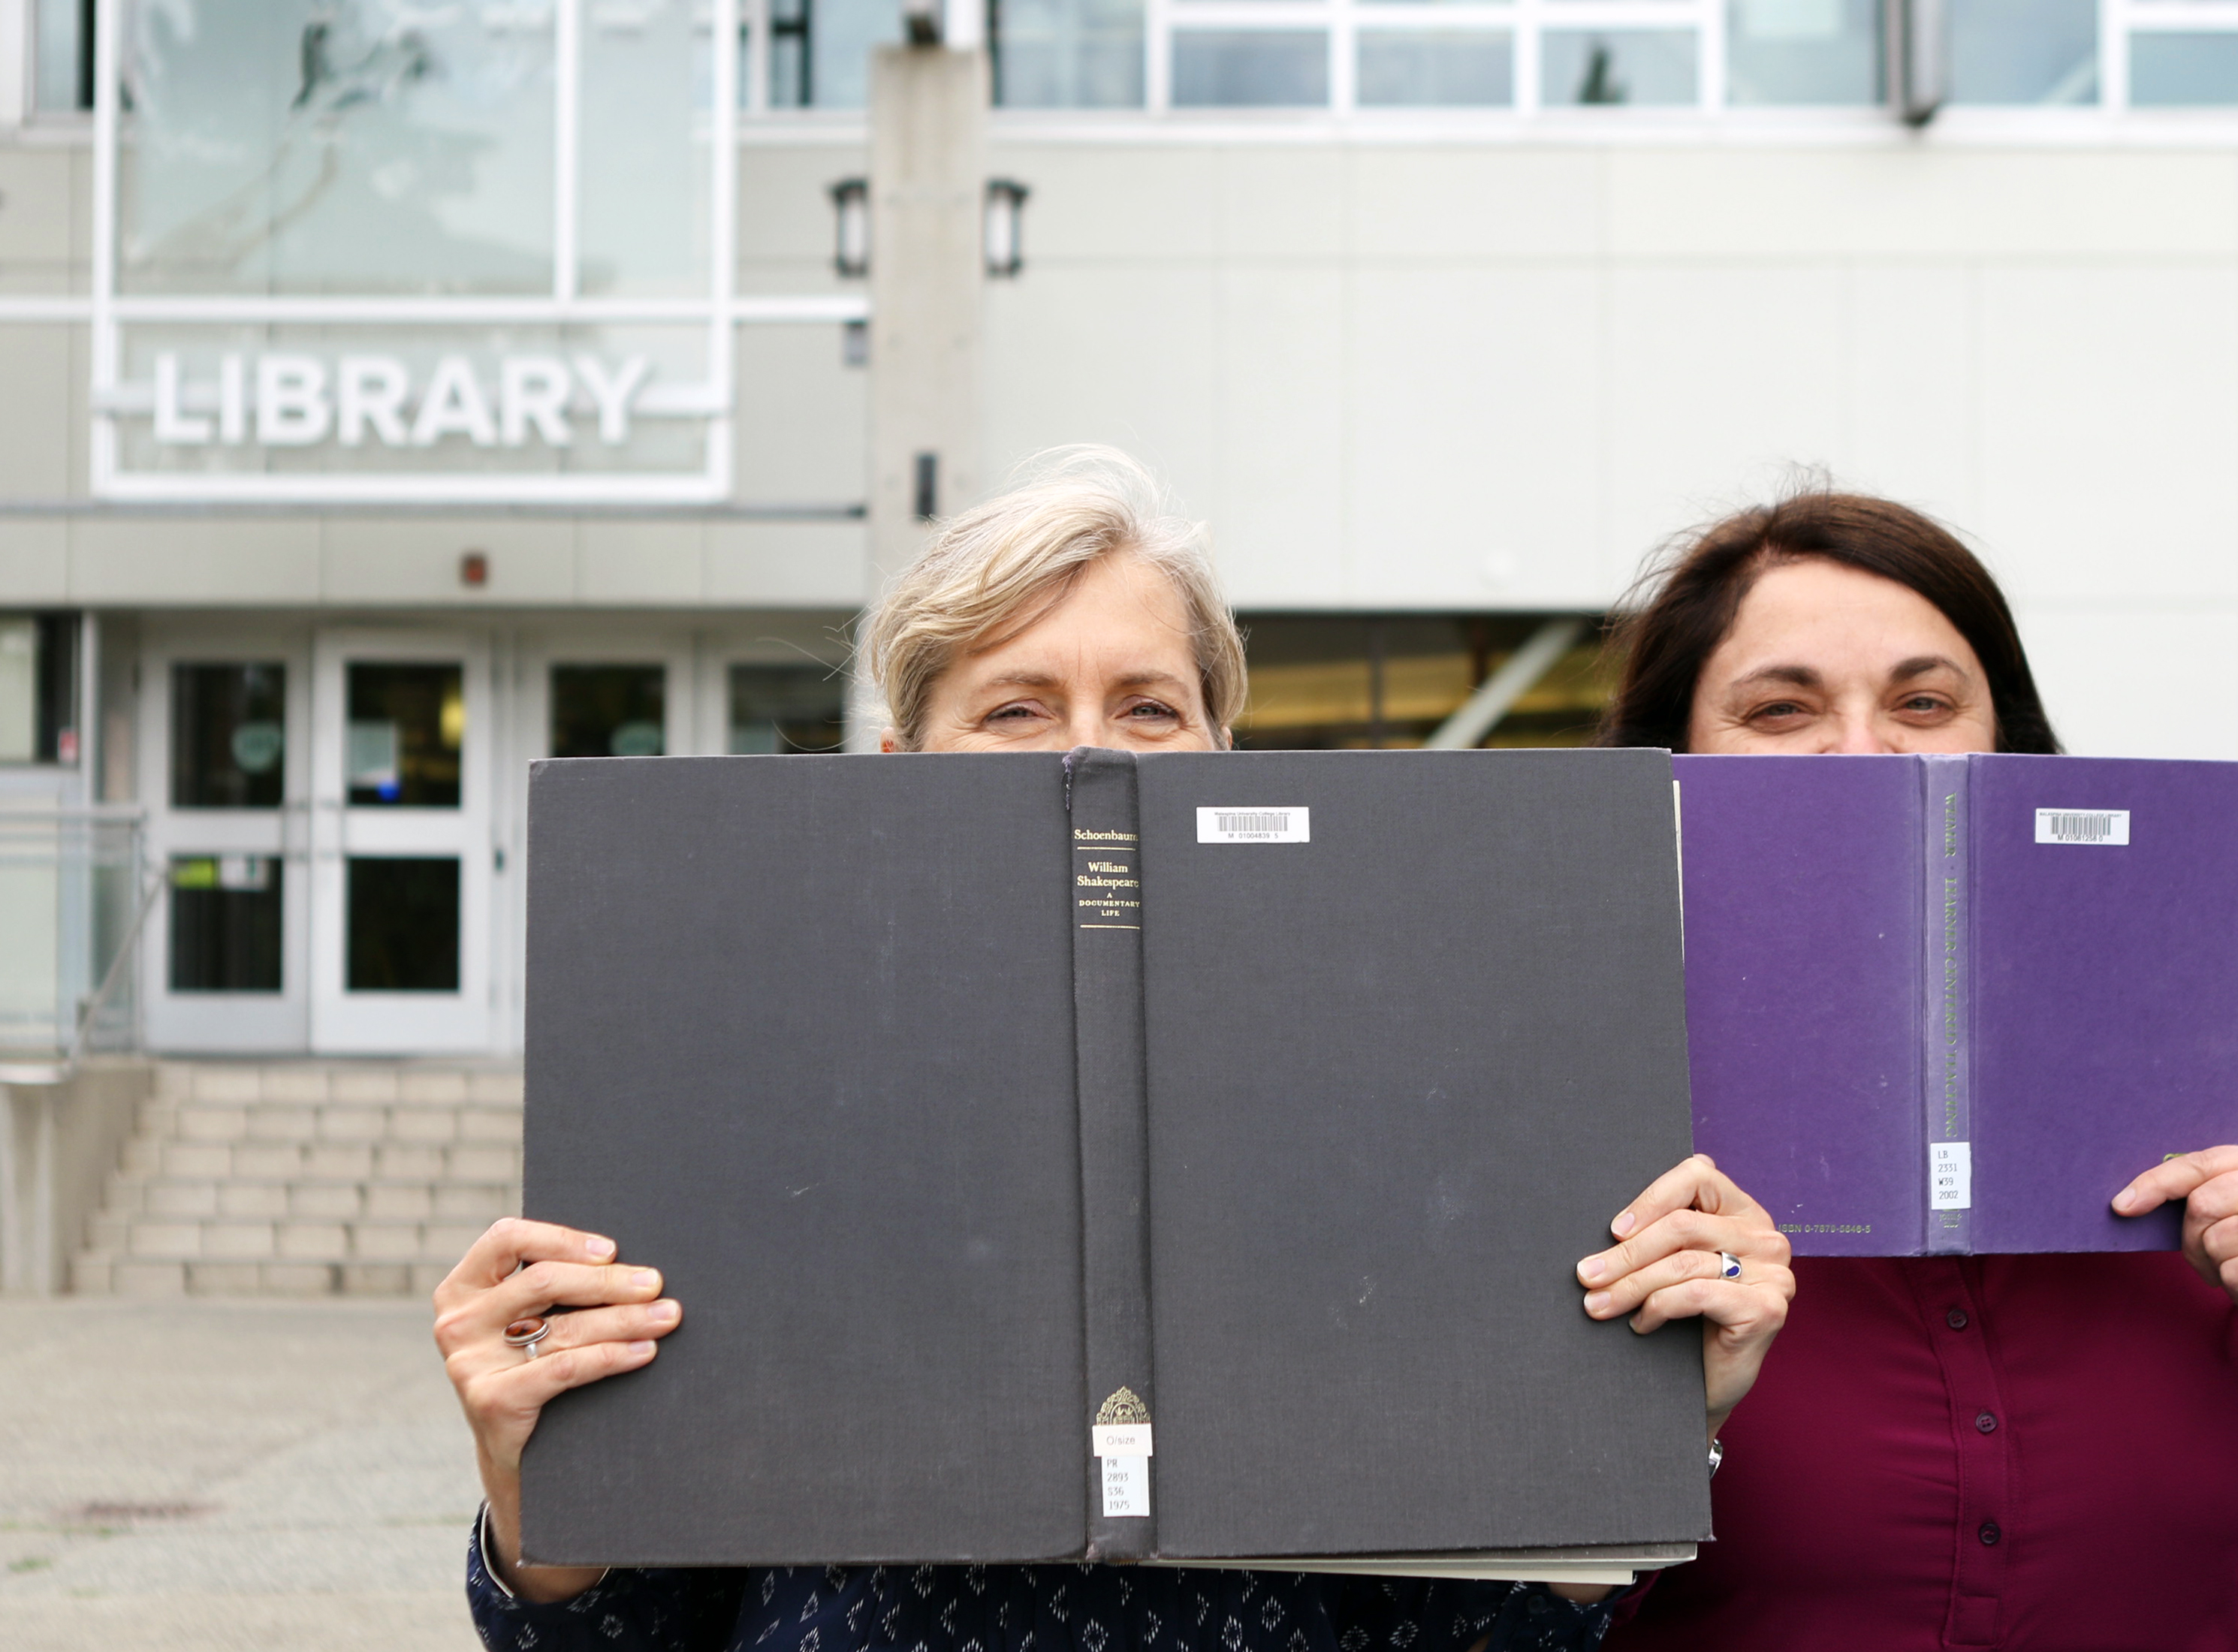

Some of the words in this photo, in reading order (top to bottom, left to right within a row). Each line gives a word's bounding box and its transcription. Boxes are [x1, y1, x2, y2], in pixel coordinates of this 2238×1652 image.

[152, 351, 648, 445] LIBRARY
[1945, 792, 1956, 858] WEIMER
[1087, 861, 1128, 873] William
[1077, 876, 1139, 890] Shakespeare
[1078, 900, 1140, 908] DOCUMENTARY
[1946, 1050, 1957, 1137] TEACHING
[1938, 1150, 1949, 1159] LB
[1938, 1164, 1958, 1172] 2331
[1938, 1177, 1953, 1186] W39
[1938, 1190, 1959, 1200] 2002
[1778, 1224, 1802, 1233] ISBN
[1106, 1435, 1136, 1446] O/size
[1106, 1458, 1117, 1468] PR
[1106, 1473, 1129, 1482] 2893
[1107, 1486, 1124, 1496] S36
[1108, 1500, 1130, 1510] 1975
